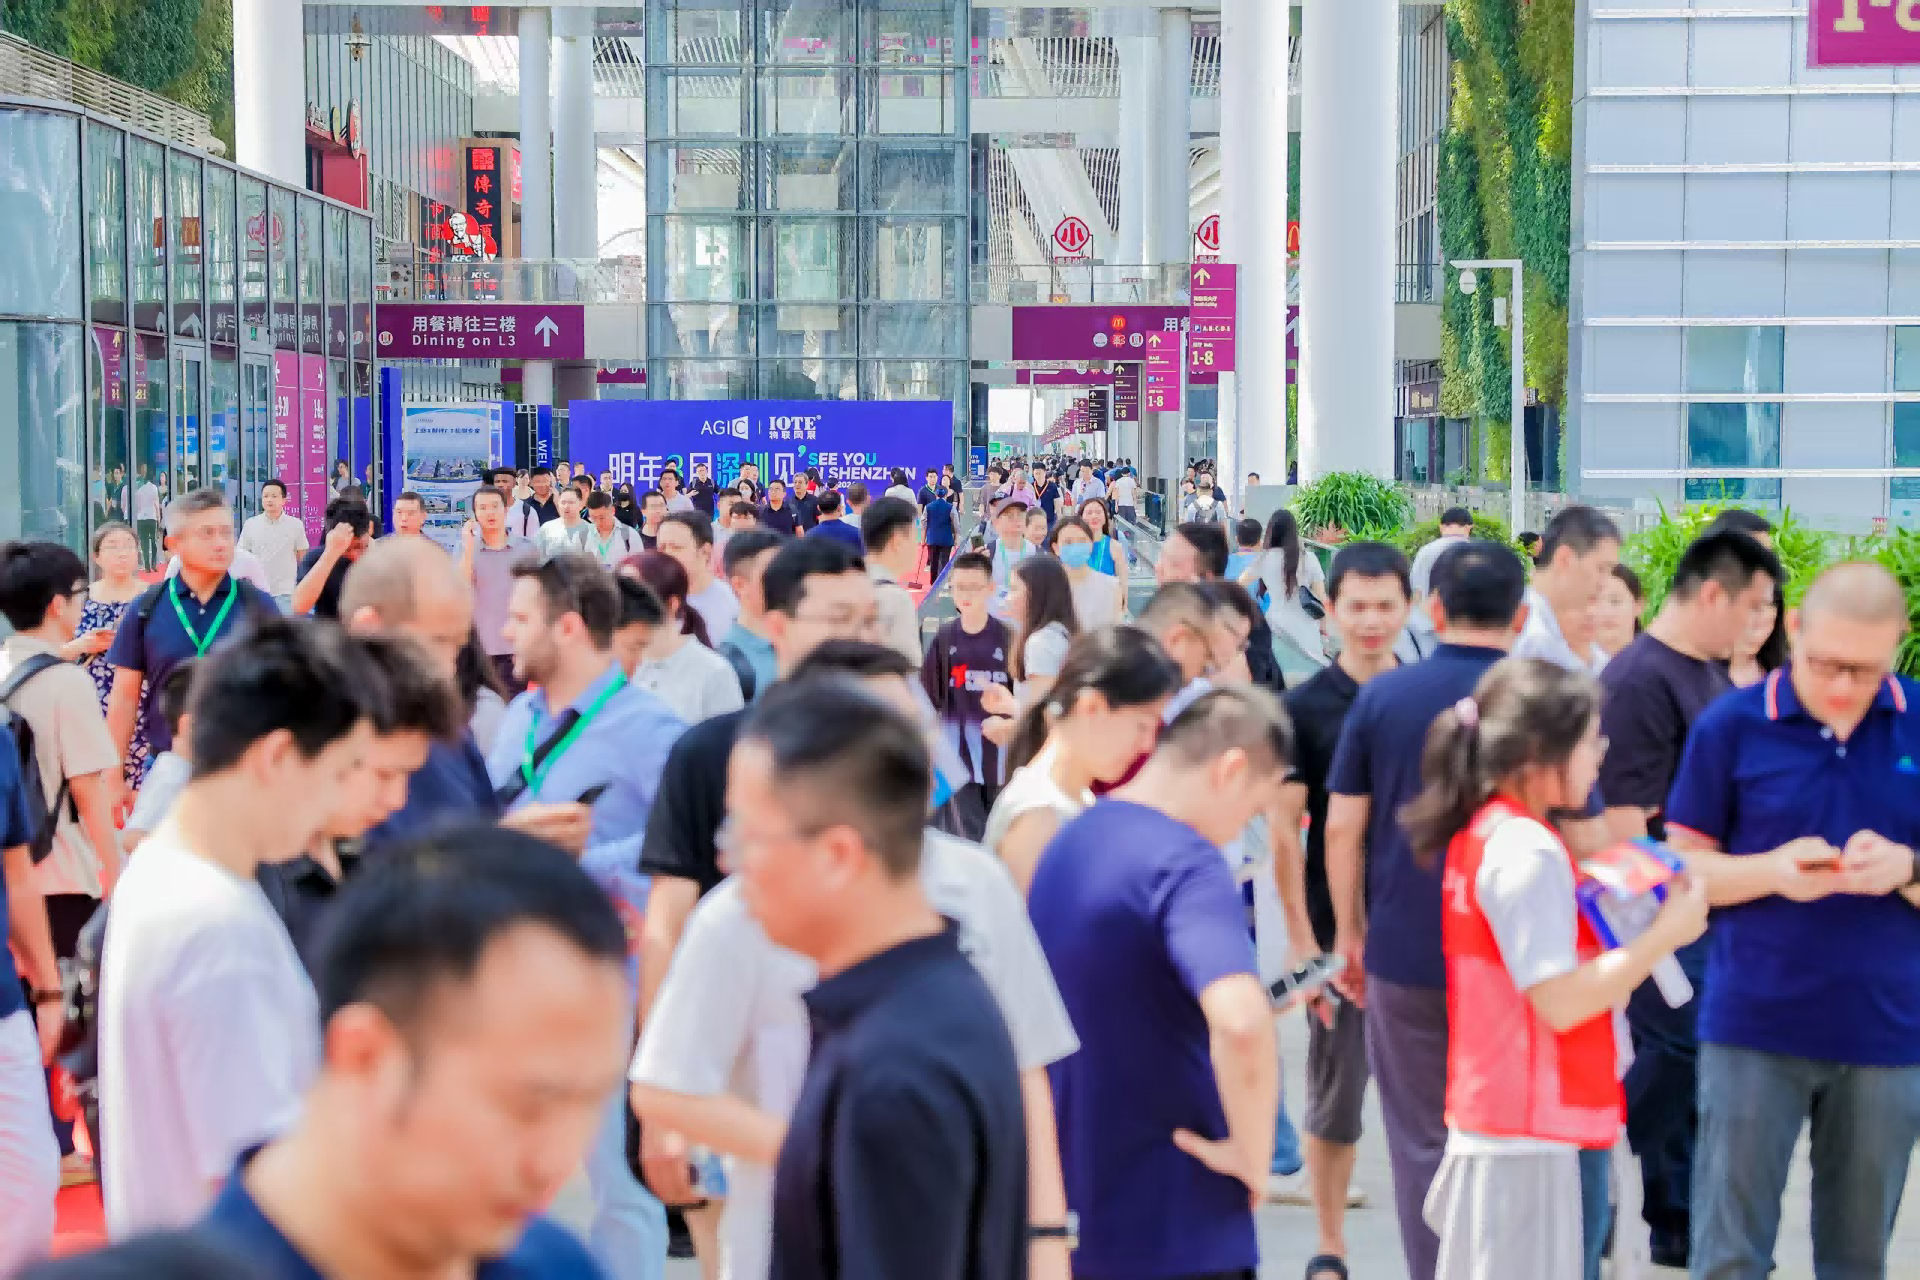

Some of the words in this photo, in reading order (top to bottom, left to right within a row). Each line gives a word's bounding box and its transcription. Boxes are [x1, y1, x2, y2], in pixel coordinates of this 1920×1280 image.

[451, 254, 472, 263] KFC
[412, 315, 516, 333] 用餐请往三楼
[412, 334, 465, 349] Dining
[472, 336, 491, 346] on
[499, 335, 516, 346] L3
[1192, 350, 1214, 366] 1-8
[1148, 395, 1164, 407] 1-8
[1115, 409, 1127, 418] 1-8
[701, 416, 748, 440] AGIC
[769, 430, 816, 440] 物联网展
[808, 452, 838, 466] SEE
[843, 452, 877, 466] YOU
[828, 467, 917, 480] SHENZHN
